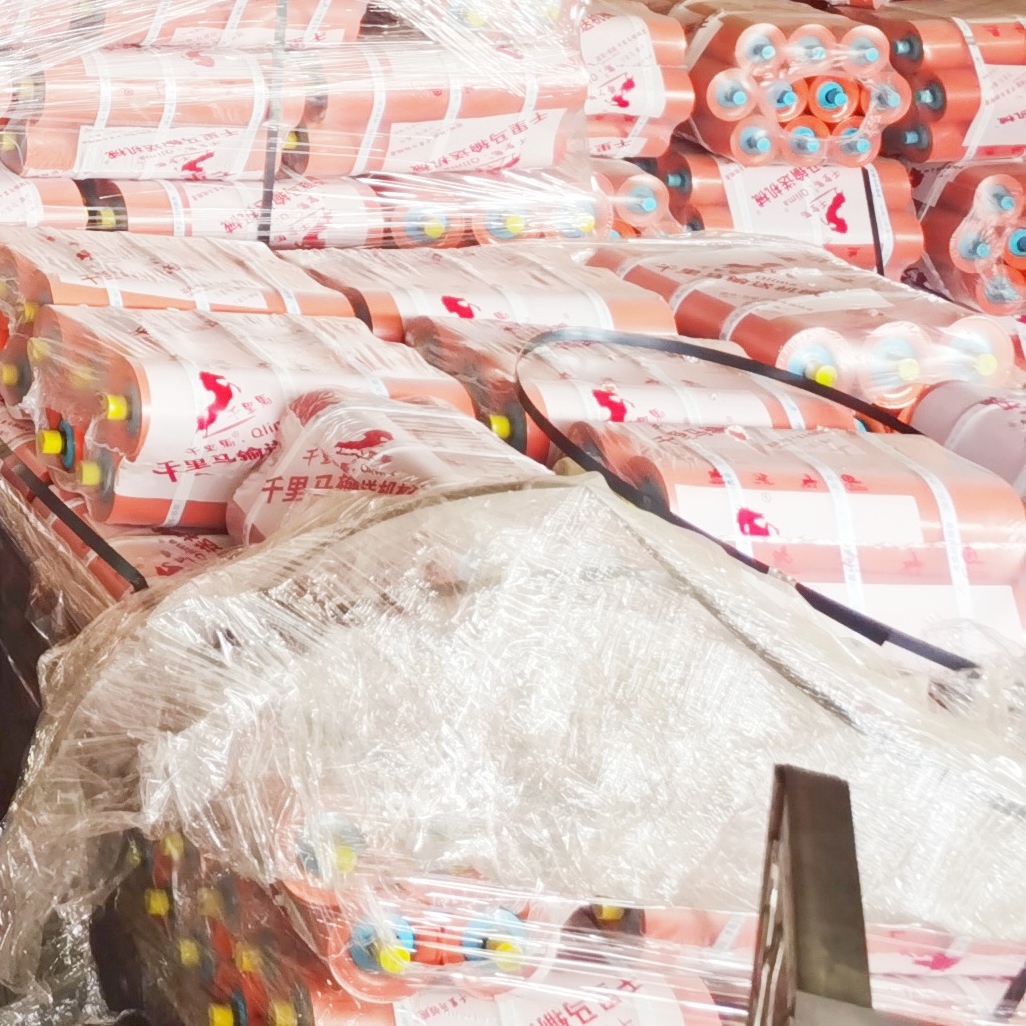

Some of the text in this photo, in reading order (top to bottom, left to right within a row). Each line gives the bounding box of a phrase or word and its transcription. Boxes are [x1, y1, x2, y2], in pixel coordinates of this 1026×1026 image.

[409, 111, 549, 175] 千里马输送机械
[782, 187, 810, 207] Qlima
